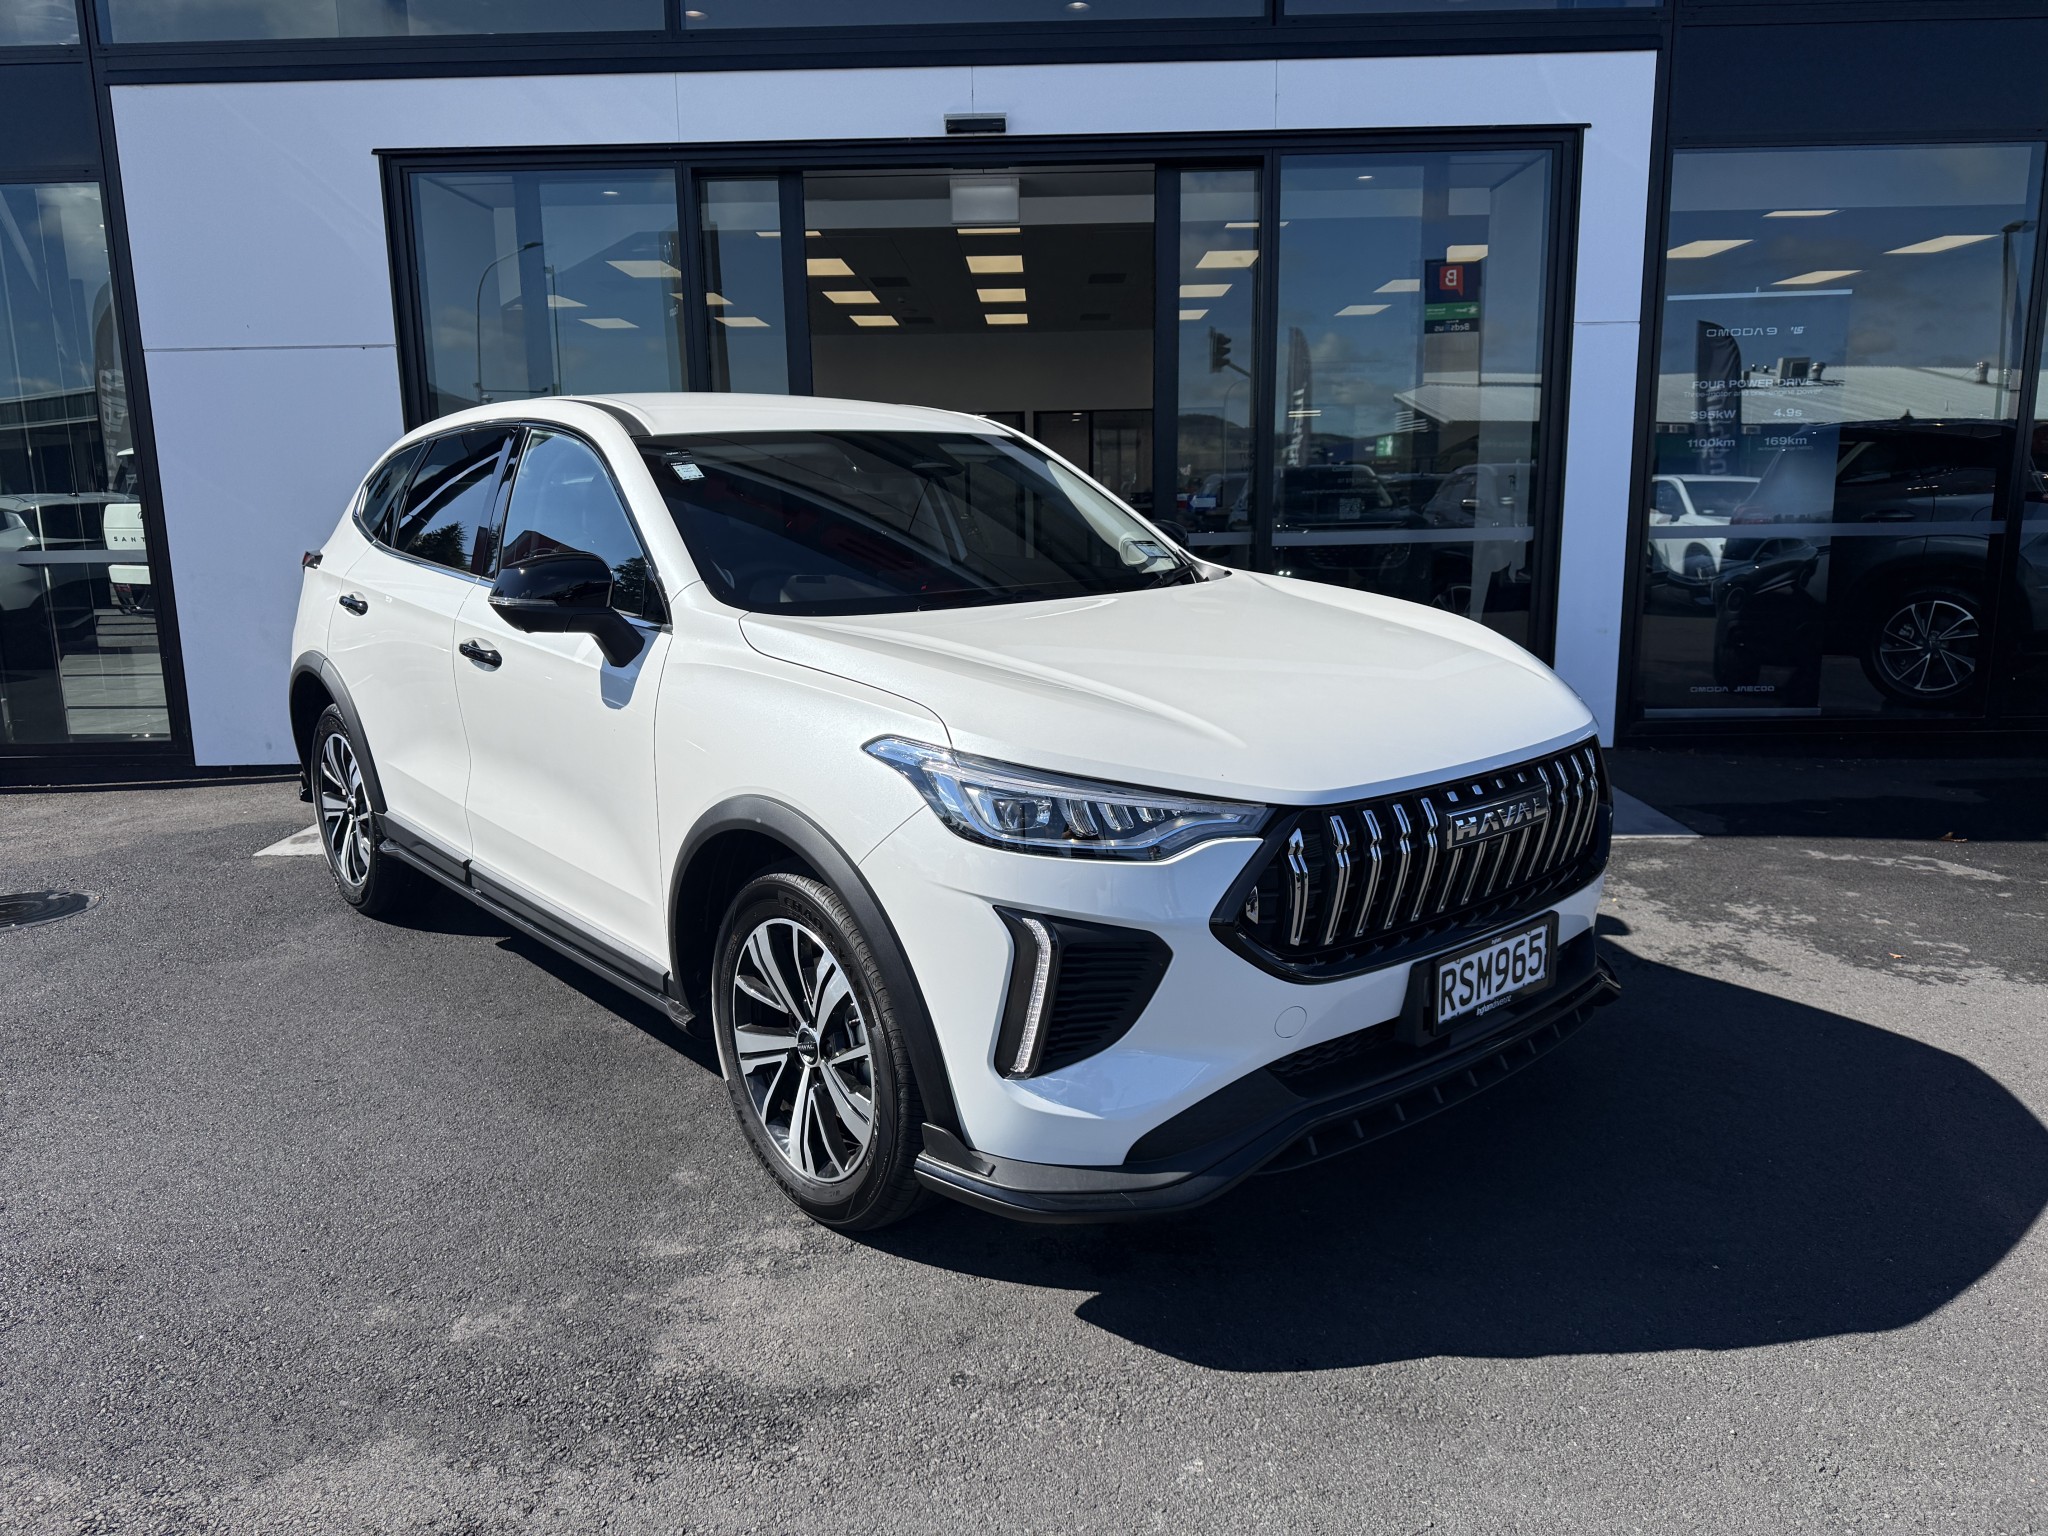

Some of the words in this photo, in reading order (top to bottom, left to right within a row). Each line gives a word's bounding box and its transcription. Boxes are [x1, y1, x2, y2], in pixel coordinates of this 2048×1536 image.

[1706, 328, 1764, 337] OMODA
[1767, 327, 1778, 335] 9
[1692, 380, 1725, 390] FOUR
[1729, 379, 1773, 388] POWER
[1777, 377, 1814, 386] DRIVE
[1690, 410, 1736, 420] 395kW
[1773, 408, 1802, 417] 4.9s
[1687, 439, 1735, 448] 1100km
[1764, 436, 1807, 446] 169km
[1455, 797, 1548, 841] HAVAL
[1440, 931, 1543, 1016] RSM965
